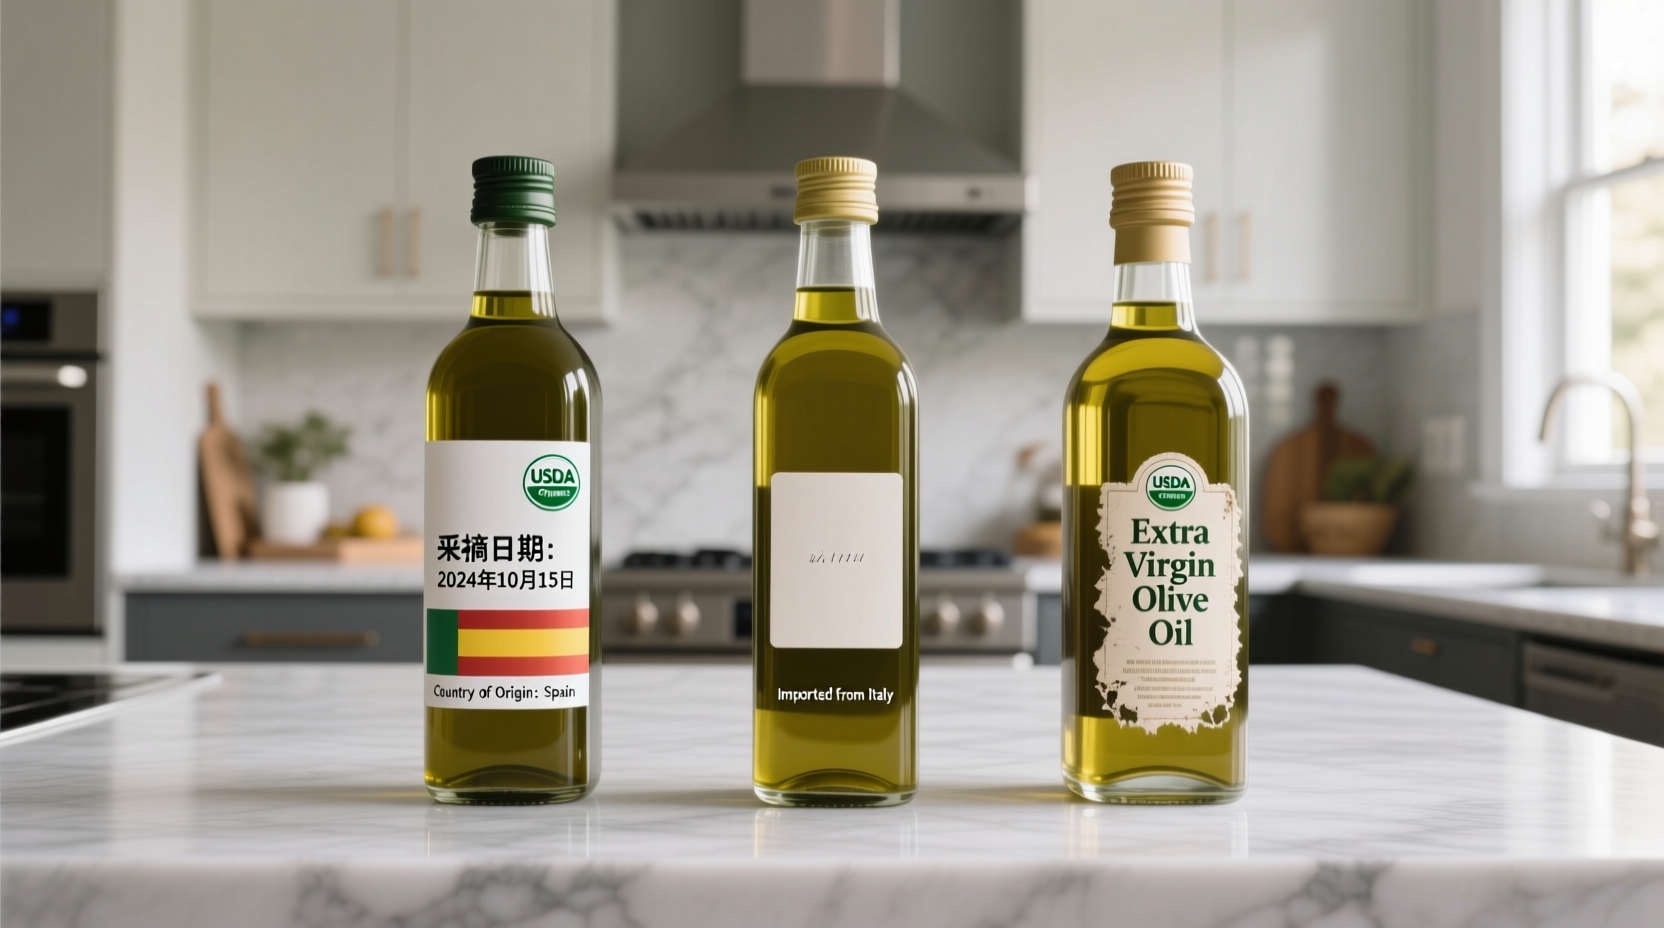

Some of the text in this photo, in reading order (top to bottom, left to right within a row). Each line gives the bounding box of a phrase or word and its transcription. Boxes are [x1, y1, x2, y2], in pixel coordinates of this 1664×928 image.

[530, 468, 575, 484] USDA
[1152, 475, 1190, 489] USDA
[1130, 518, 1210, 545] Extra
[1124, 550, 1216, 585] Virgin
[437, 569, 574, 590] 2024年10月15日
[1132, 584, 1209, 613] Olive
[1148, 618, 1194, 646] Oil
[433, 684, 576, 702] Country of Origin: Spain
[778, 687, 894, 704] Imported from Italy
